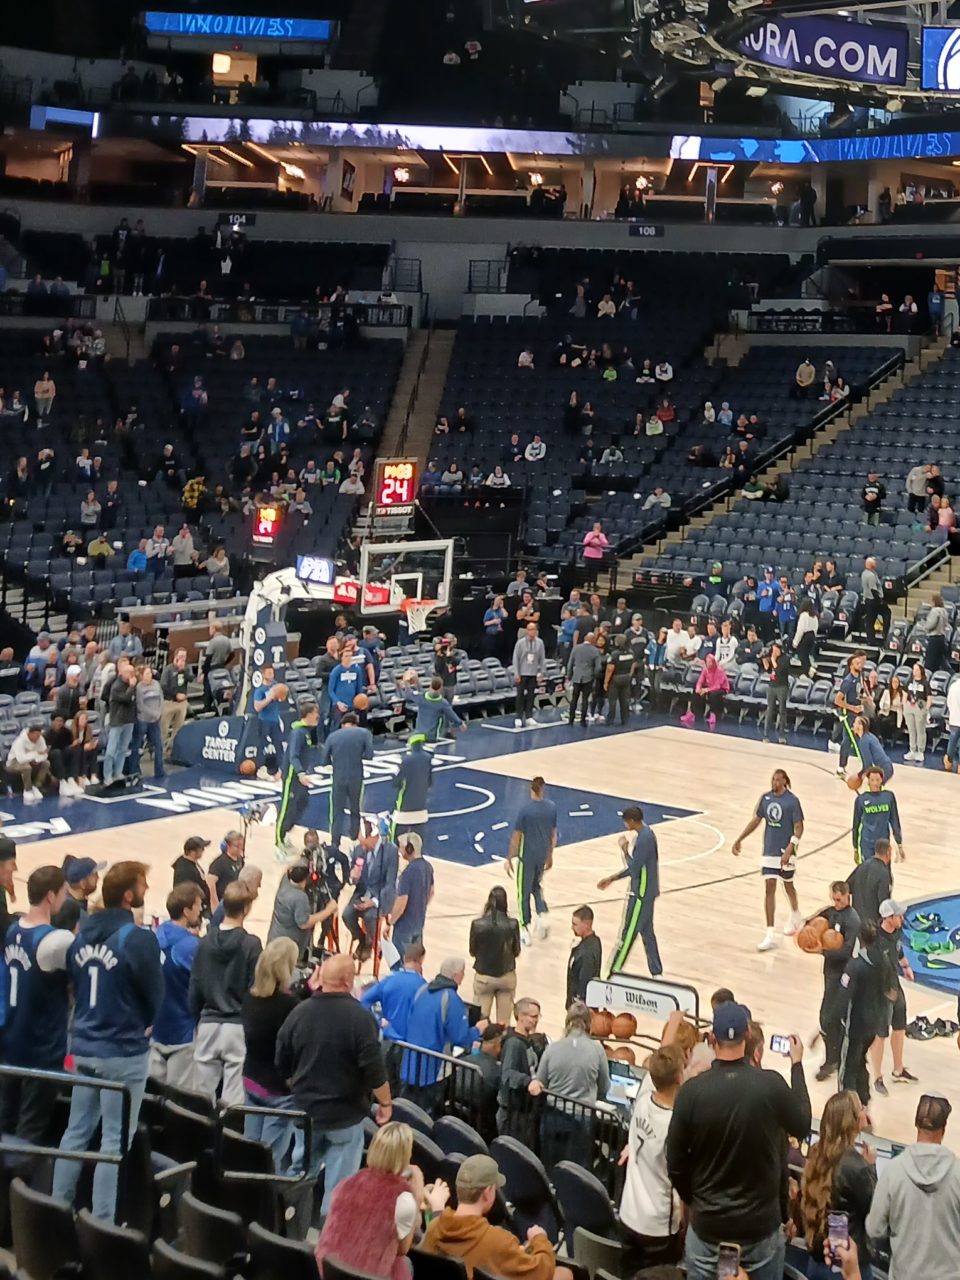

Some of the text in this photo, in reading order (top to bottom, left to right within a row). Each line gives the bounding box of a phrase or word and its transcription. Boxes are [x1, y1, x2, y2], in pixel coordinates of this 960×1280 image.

[744, 22, 898, 78] URA.COM
[381, 478, 408, 504] 24
[9, 966, 19, 1008] 1
[87, 966, 99, 1009] 1
[625, 991, 659, 1009] Wilson
[635, 1133, 646, 1165] 7
